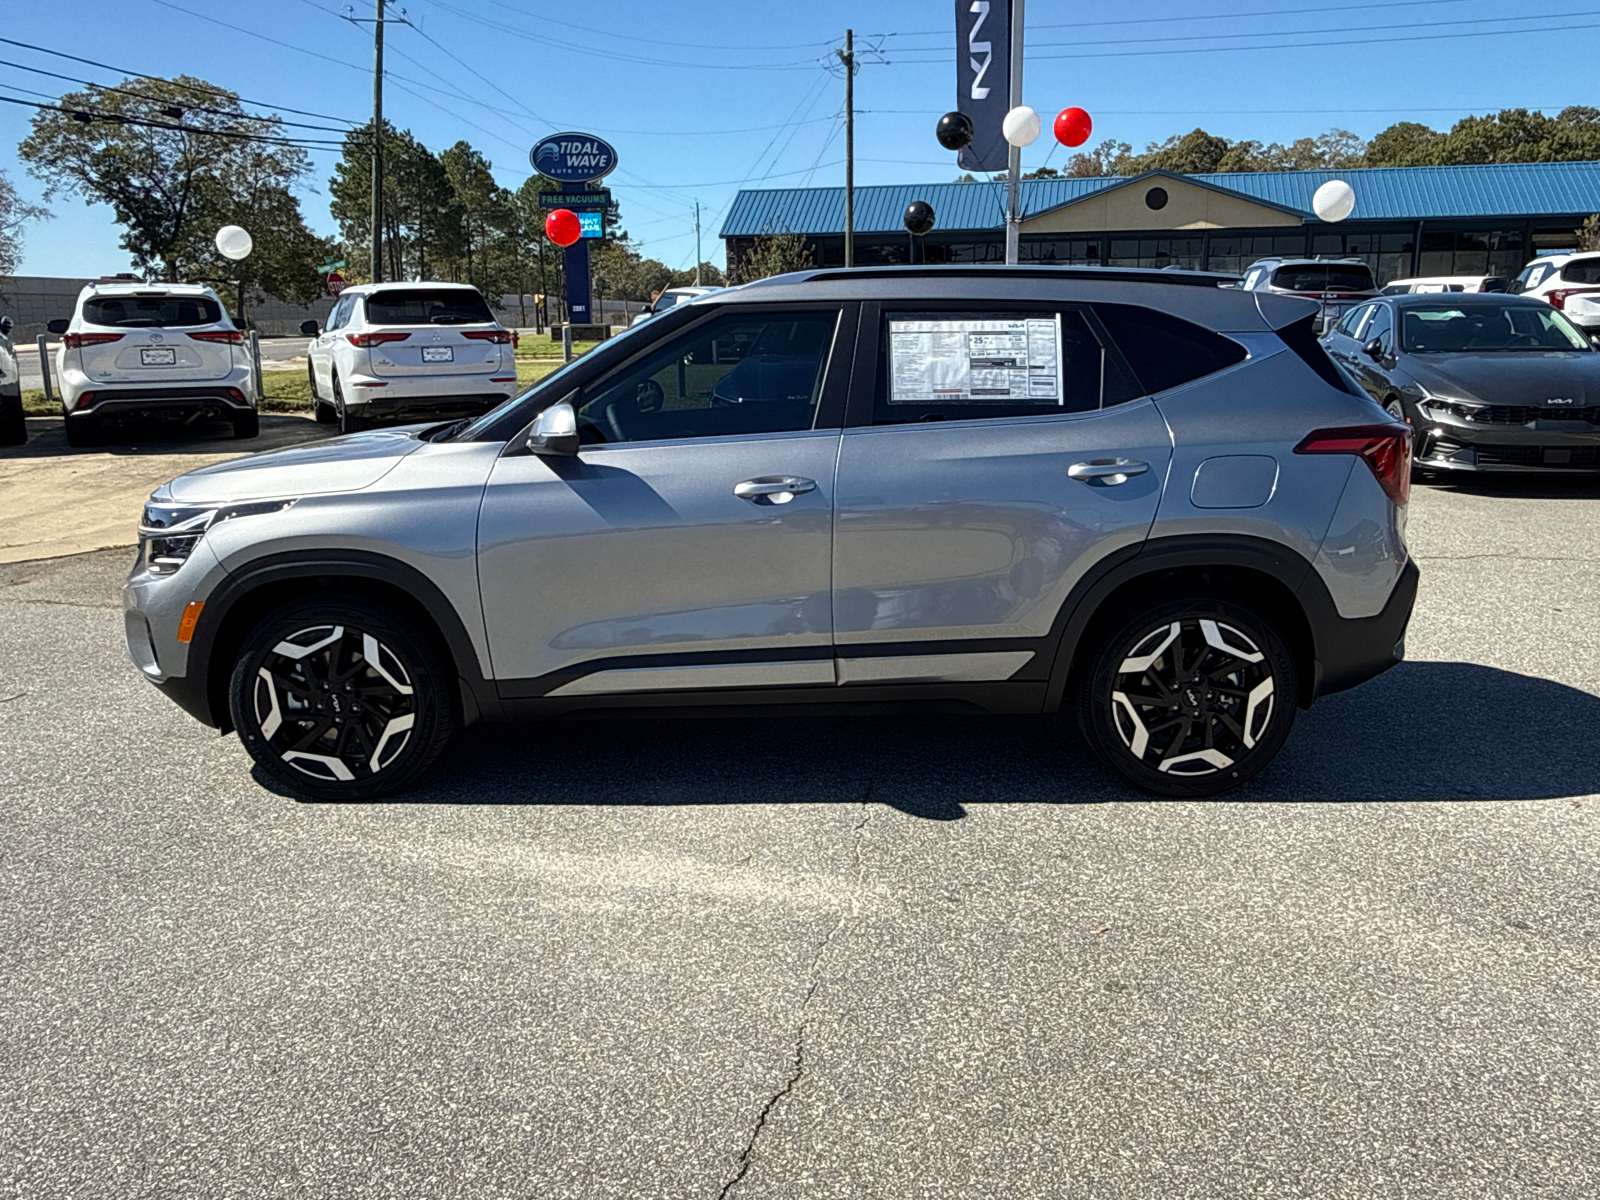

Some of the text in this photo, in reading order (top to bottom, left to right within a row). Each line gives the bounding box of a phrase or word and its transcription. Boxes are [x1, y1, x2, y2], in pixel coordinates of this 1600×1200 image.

[560, 142, 599, 154] TIDAL
[566, 155, 608, 167] WAVE
[542, 194, 605, 204] FREE VACUUMS
[329, 281, 345, 292] STOP
